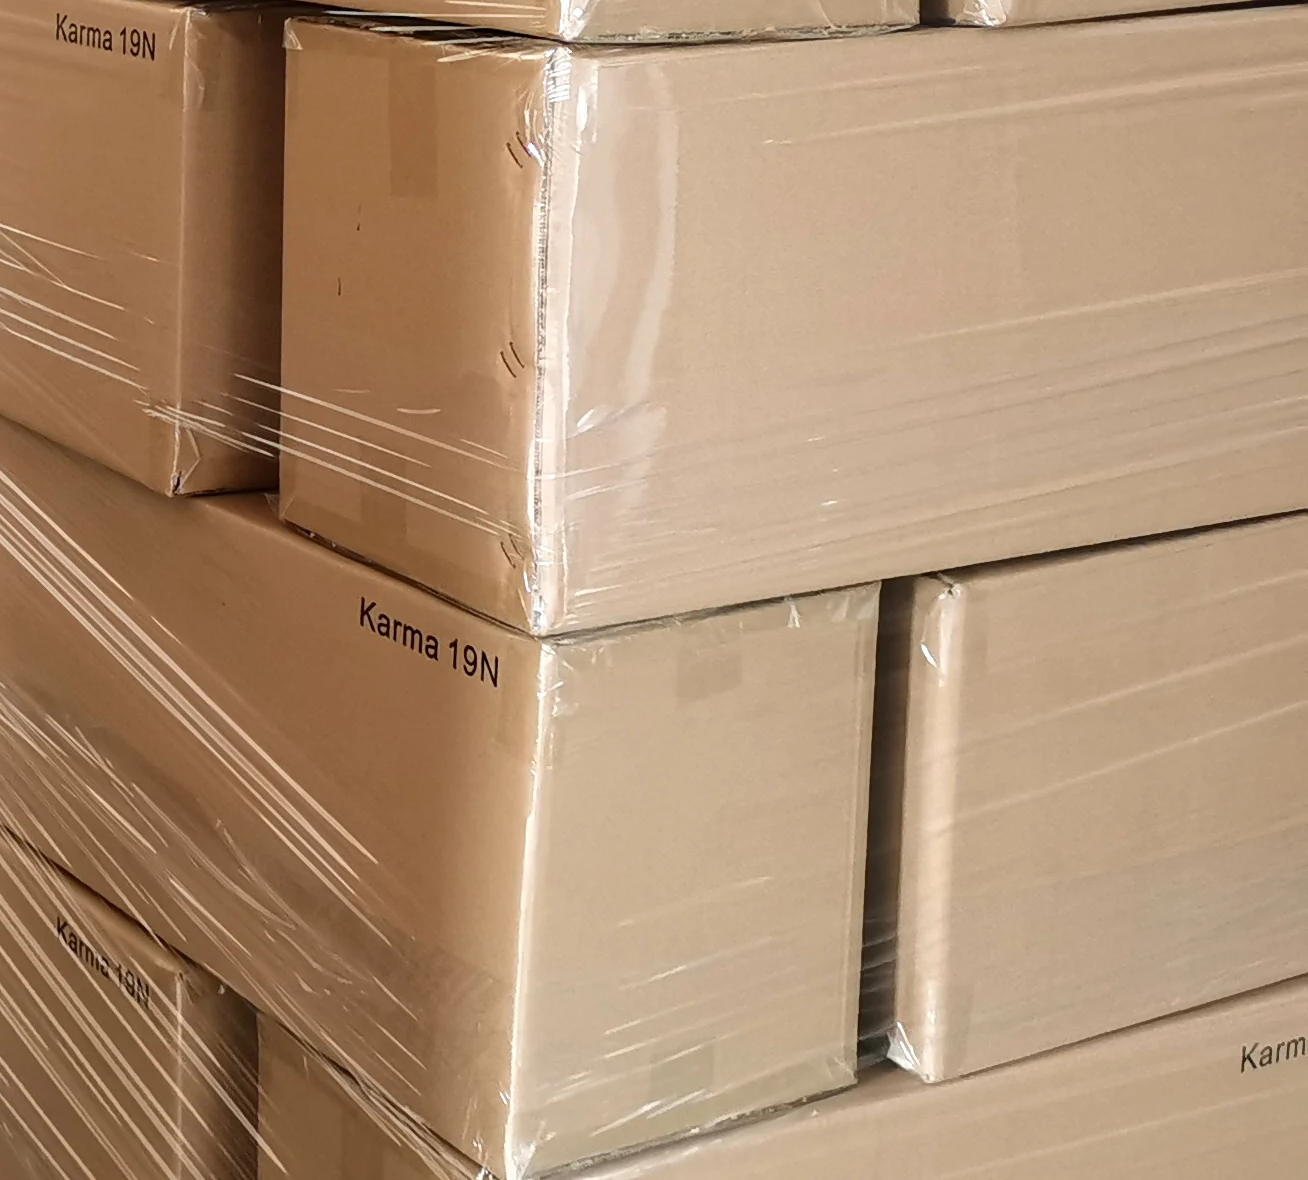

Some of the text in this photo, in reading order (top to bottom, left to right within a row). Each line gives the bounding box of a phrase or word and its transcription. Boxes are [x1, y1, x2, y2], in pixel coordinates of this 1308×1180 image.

[55, 12, 156, 61] Karma 19N
[359, 596, 499, 688] Karma 19N
[56, 915, 110, 980] Karma
[1240, 1036, 1308, 1073] Karm
